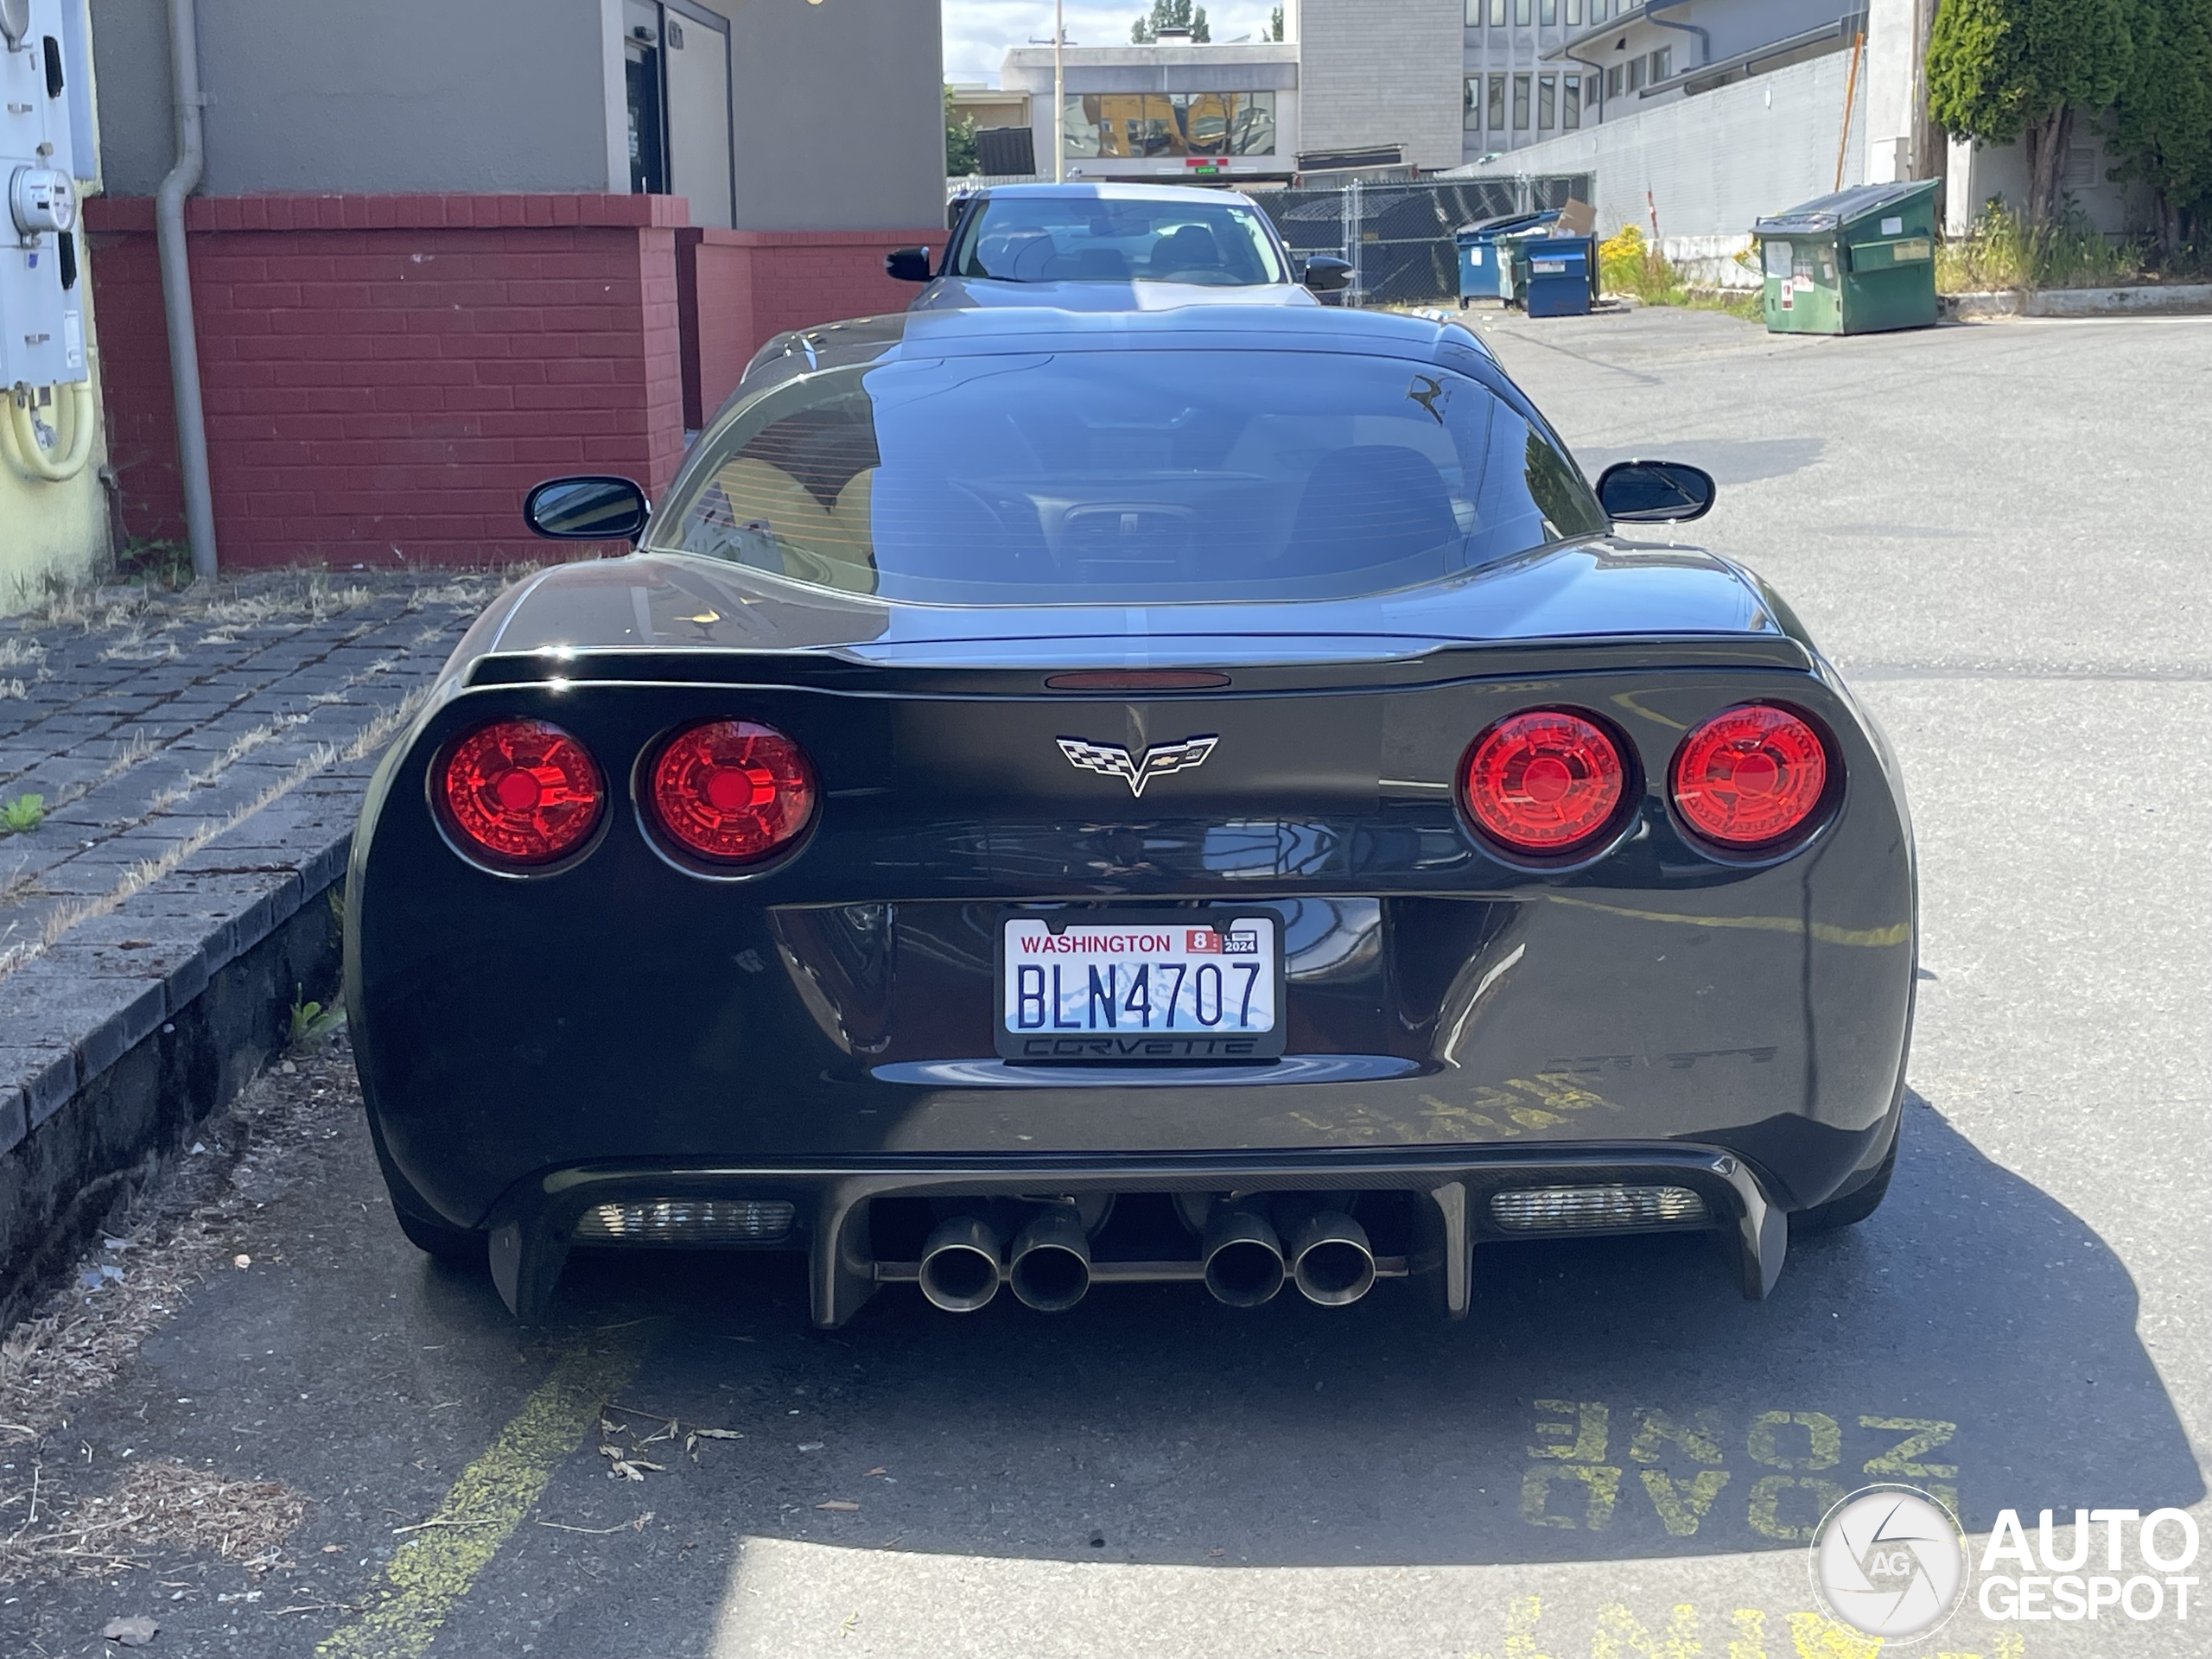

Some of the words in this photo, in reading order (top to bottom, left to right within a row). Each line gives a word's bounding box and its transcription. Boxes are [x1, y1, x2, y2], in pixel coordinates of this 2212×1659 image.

[1020, 935, 1170, 952] WASHINGTON
[1193, 931, 1207, 949] 8
[1224, 941, 1255, 952] 2024
[1017, 963, 1260, 1028] BLN4707
[1023, 1038, 1258, 1055] CORVETTE
[1524, 1398, 1959, 1478] ZONE
